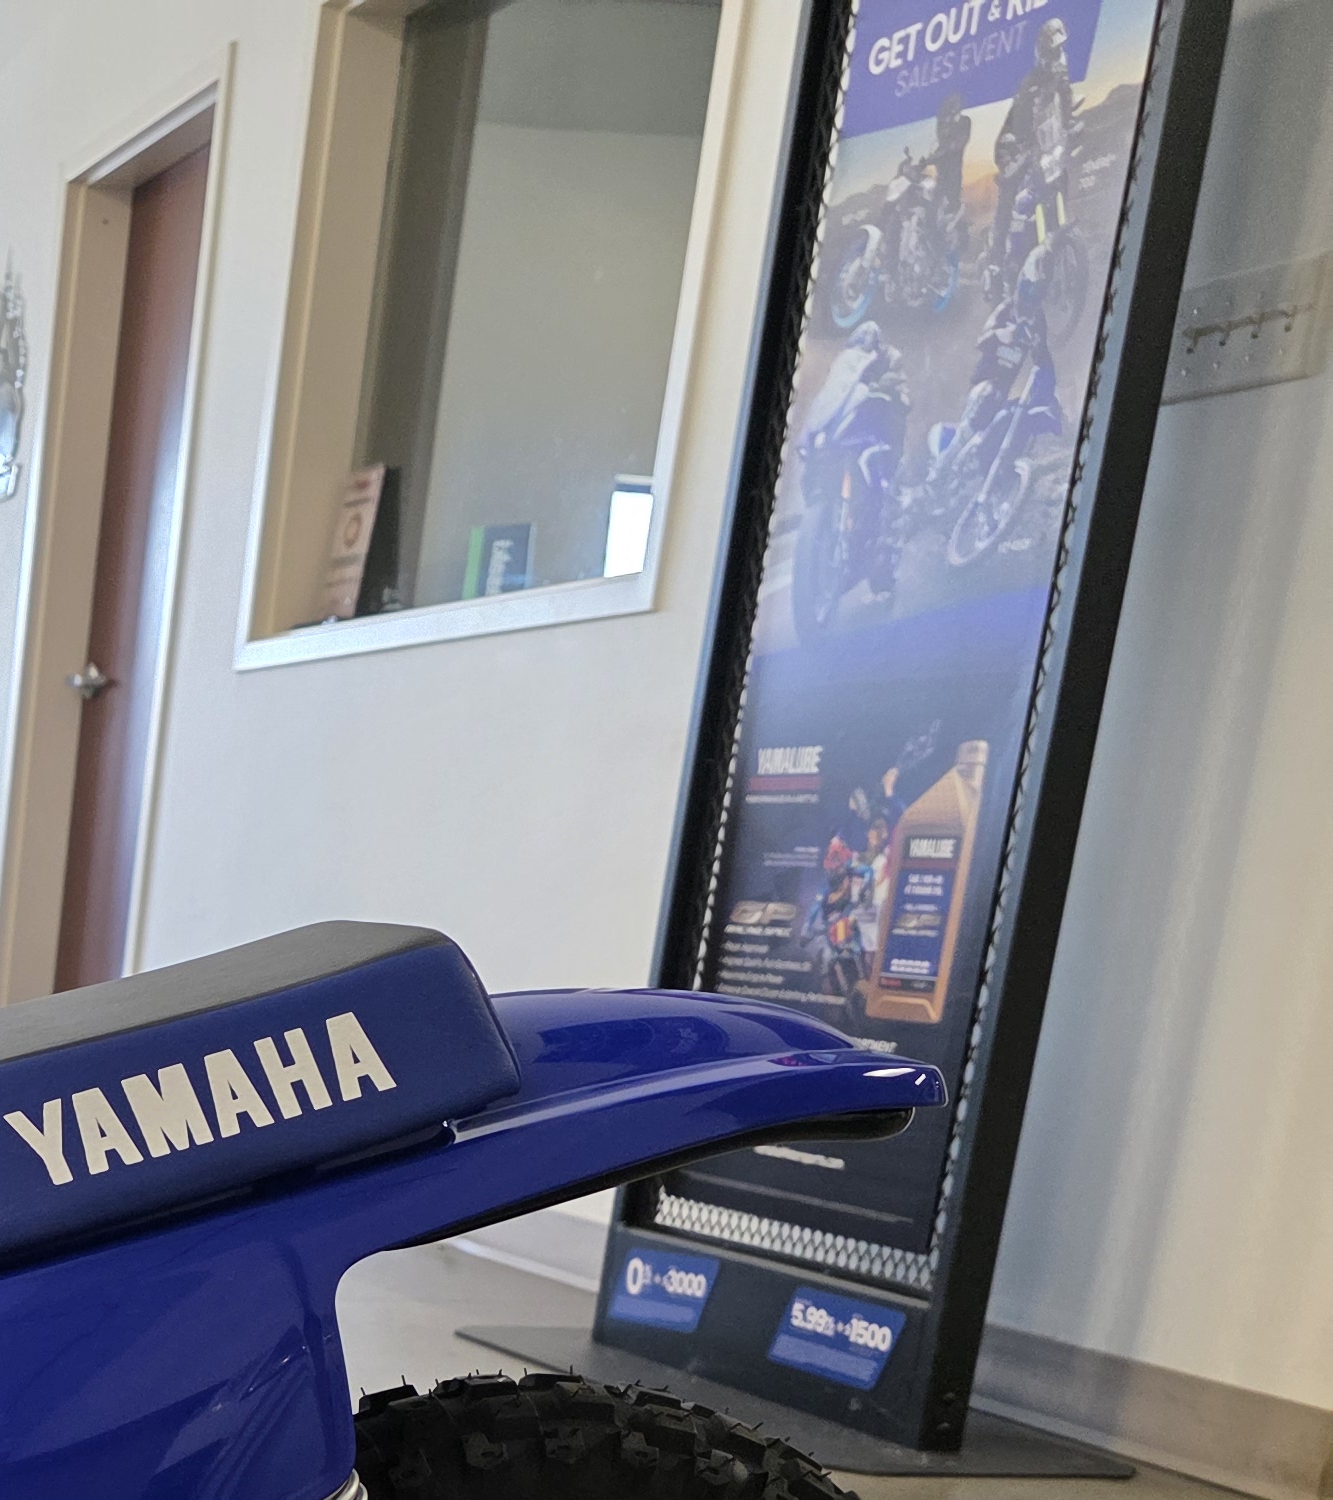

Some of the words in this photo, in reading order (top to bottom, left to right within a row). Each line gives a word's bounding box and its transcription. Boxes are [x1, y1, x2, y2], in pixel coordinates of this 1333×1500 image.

[868, 22, 923, 75] GET
[925, 0, 983, 52] OUT
[894, 51, 955, 97] SALES
[959, 20, 1027, 73] EVENT
[757, 745, 823, 775] YAMALUBE
[3, 1012, 397, 1186] YAMAHA
